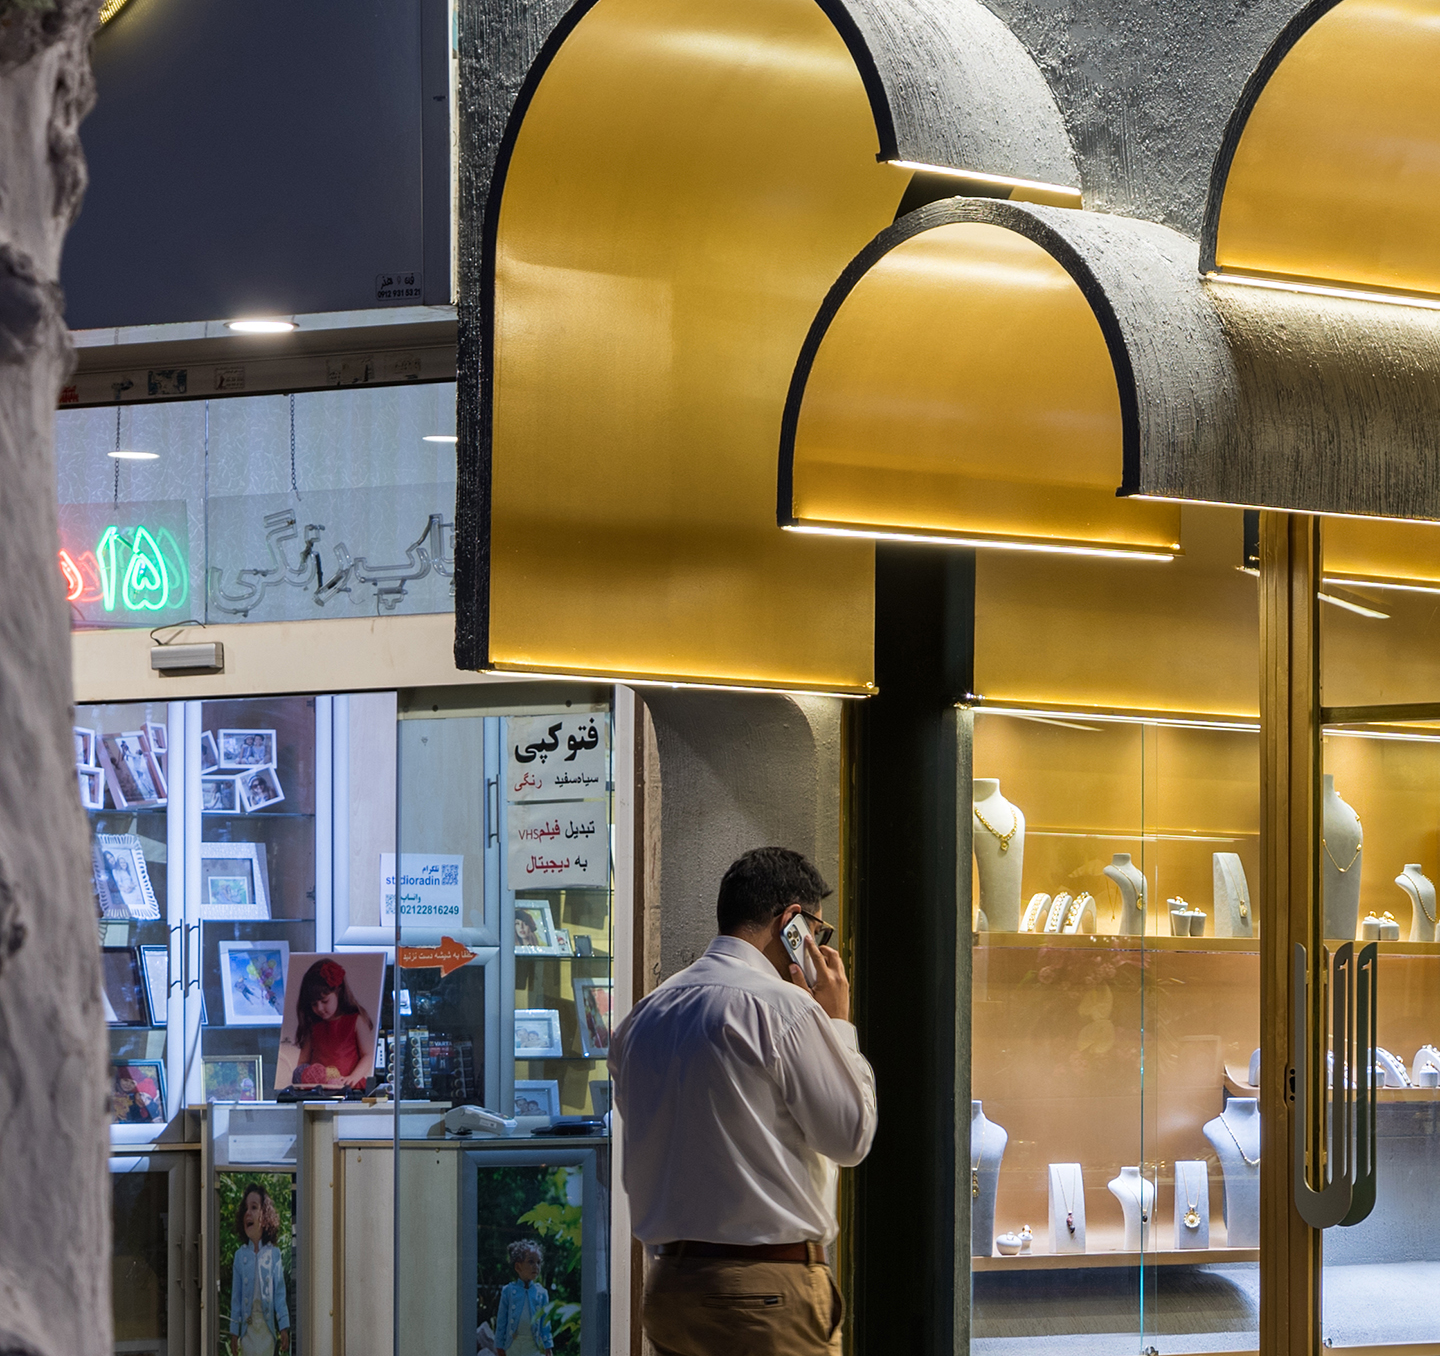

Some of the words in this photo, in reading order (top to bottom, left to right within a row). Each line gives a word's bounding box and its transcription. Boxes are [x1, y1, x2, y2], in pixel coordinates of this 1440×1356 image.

[514, 772, 542, 792] رنگی
[518, 828, 540, 841] VHS
[538, 819, 561, 843] فیلم
[565, 820, 595, 839] تبدیل
[526, 855, 570, 874] دیجیتال
[574, 855, 588, 872] به
[385, 875, 440, 886] stdioradin
[400, 904, 459, 915] 02122816249
